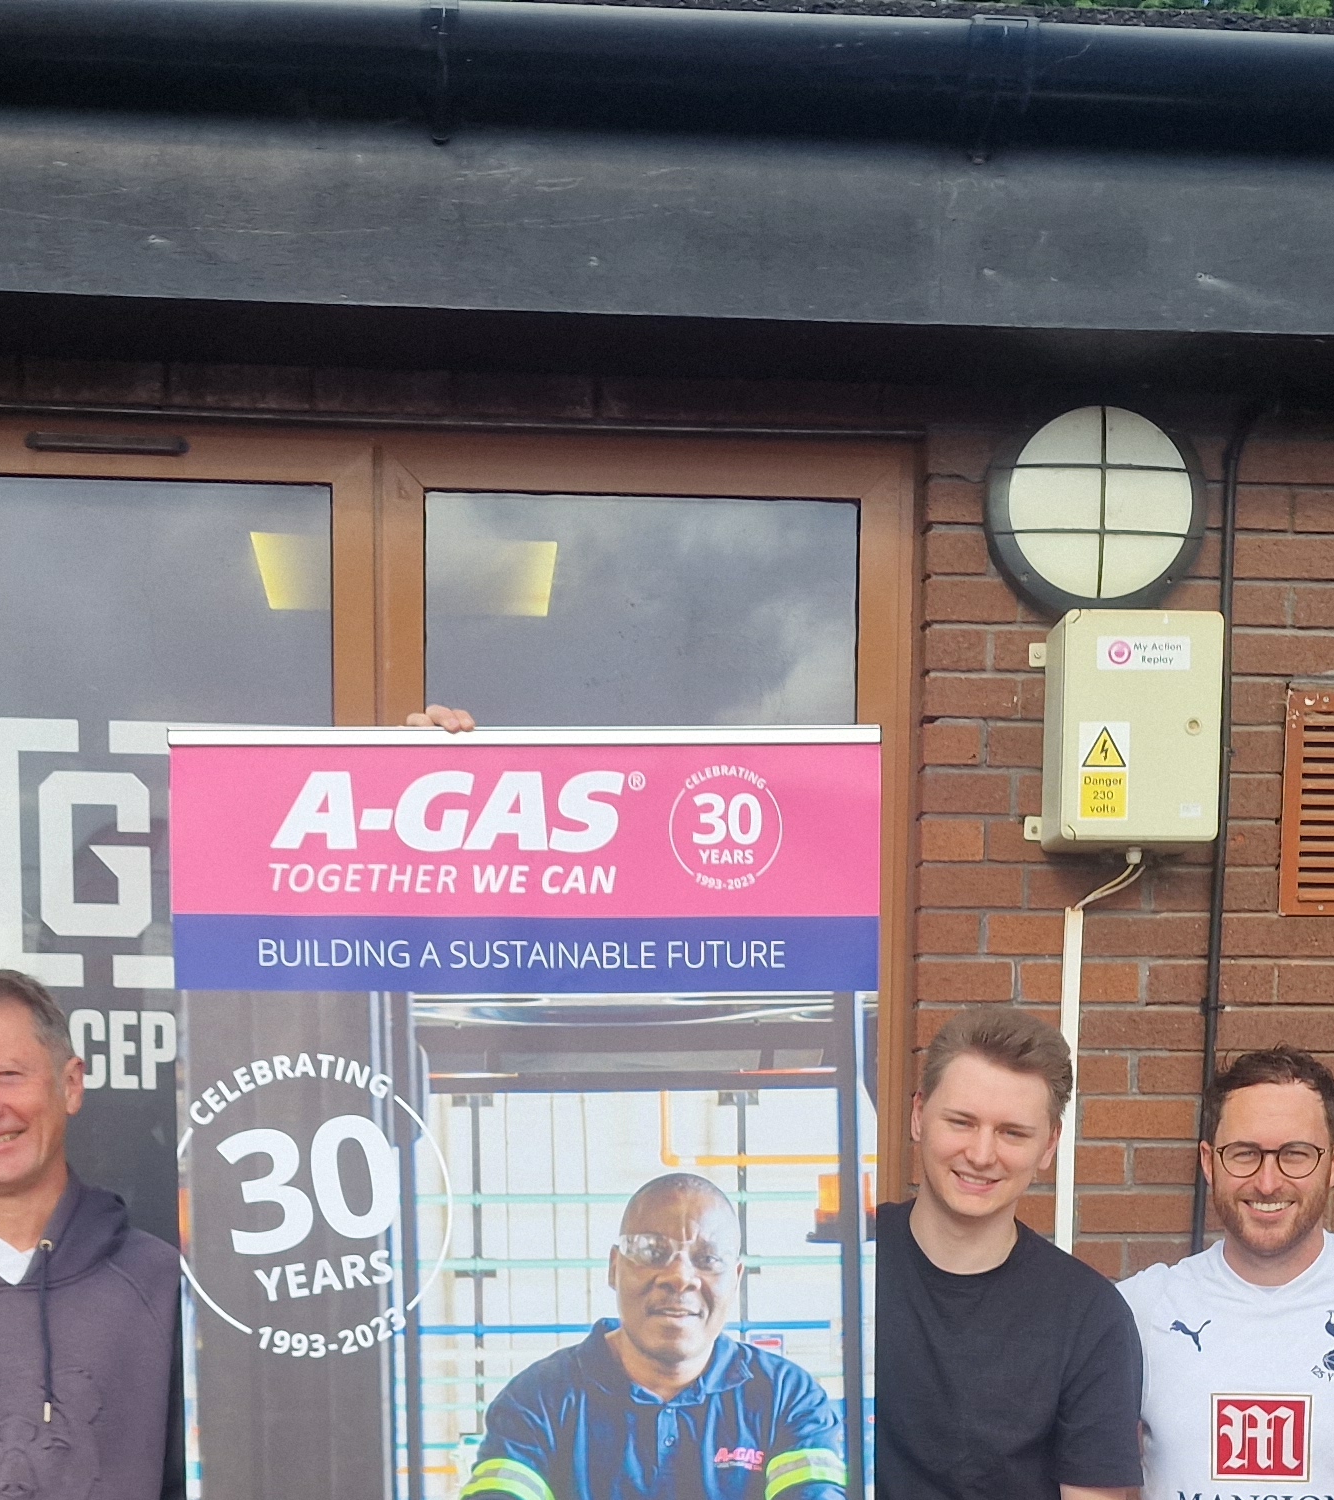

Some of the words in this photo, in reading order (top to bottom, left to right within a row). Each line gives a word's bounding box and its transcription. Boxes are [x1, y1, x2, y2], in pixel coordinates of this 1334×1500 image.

[1133, 642, 1148, 653] My
[1151, 641, 1183, 653] Action
[1140, 654, 1175, 666] Replay
[684, 764, 767, 790] CELEBRATING
[1083, 776, 1123, 787] Danger
[1092, 790, 1114, 801] 230
[692, 792, 763, 846] 30
[1089, 804, 1116, 814] volts
[698, 848, 755, 865] YEARS
[268, 862, 458, 893] TOGETHER
[472, 865, 530, 894] WE
[541, 865, 617, 894] CAN
[694, 872, 757, 891] 1993-2023
[258, 938, 410, 968] BUILDING
[419, 940, 442, 969] A
[449, 939, 657, 970] SUSTAINABLE
[666, 939, 787, 970] FUTURE
[188, 1052, 394, 1126] CELEBRATING
[215, 1114, 401, 1256] 30
[253, 1248, 395, 1302] YEARS
[257, 1306, 407, 1359] 1993-2023
[714, 1446, 765, 1465] A-GAS
